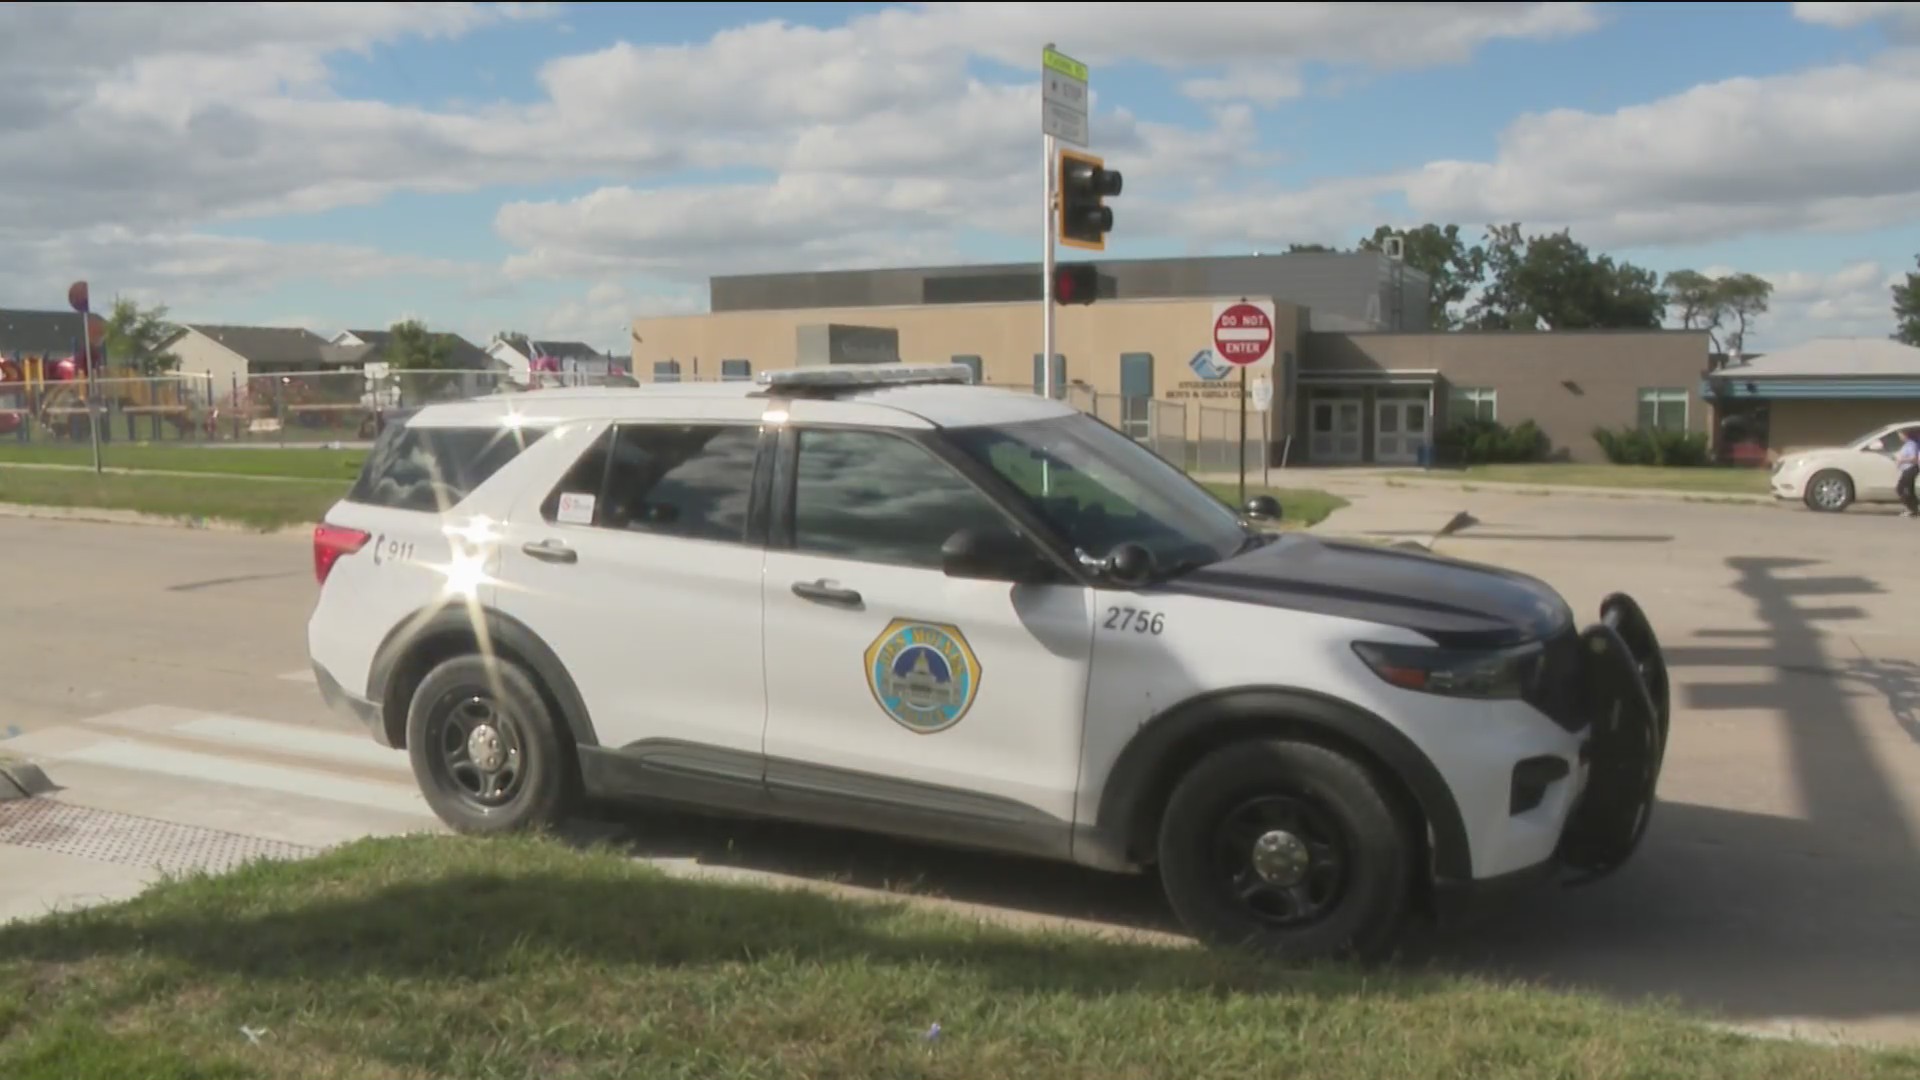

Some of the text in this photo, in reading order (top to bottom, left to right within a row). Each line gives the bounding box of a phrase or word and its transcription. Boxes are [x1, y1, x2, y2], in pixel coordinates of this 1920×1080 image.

[1221, 315, 1265, 326] DO NOT
[1225, 343, 1260, 353] ENTER
[387, 540, 414, 560] 911
[1103, 606, 1166, 636] 2756
